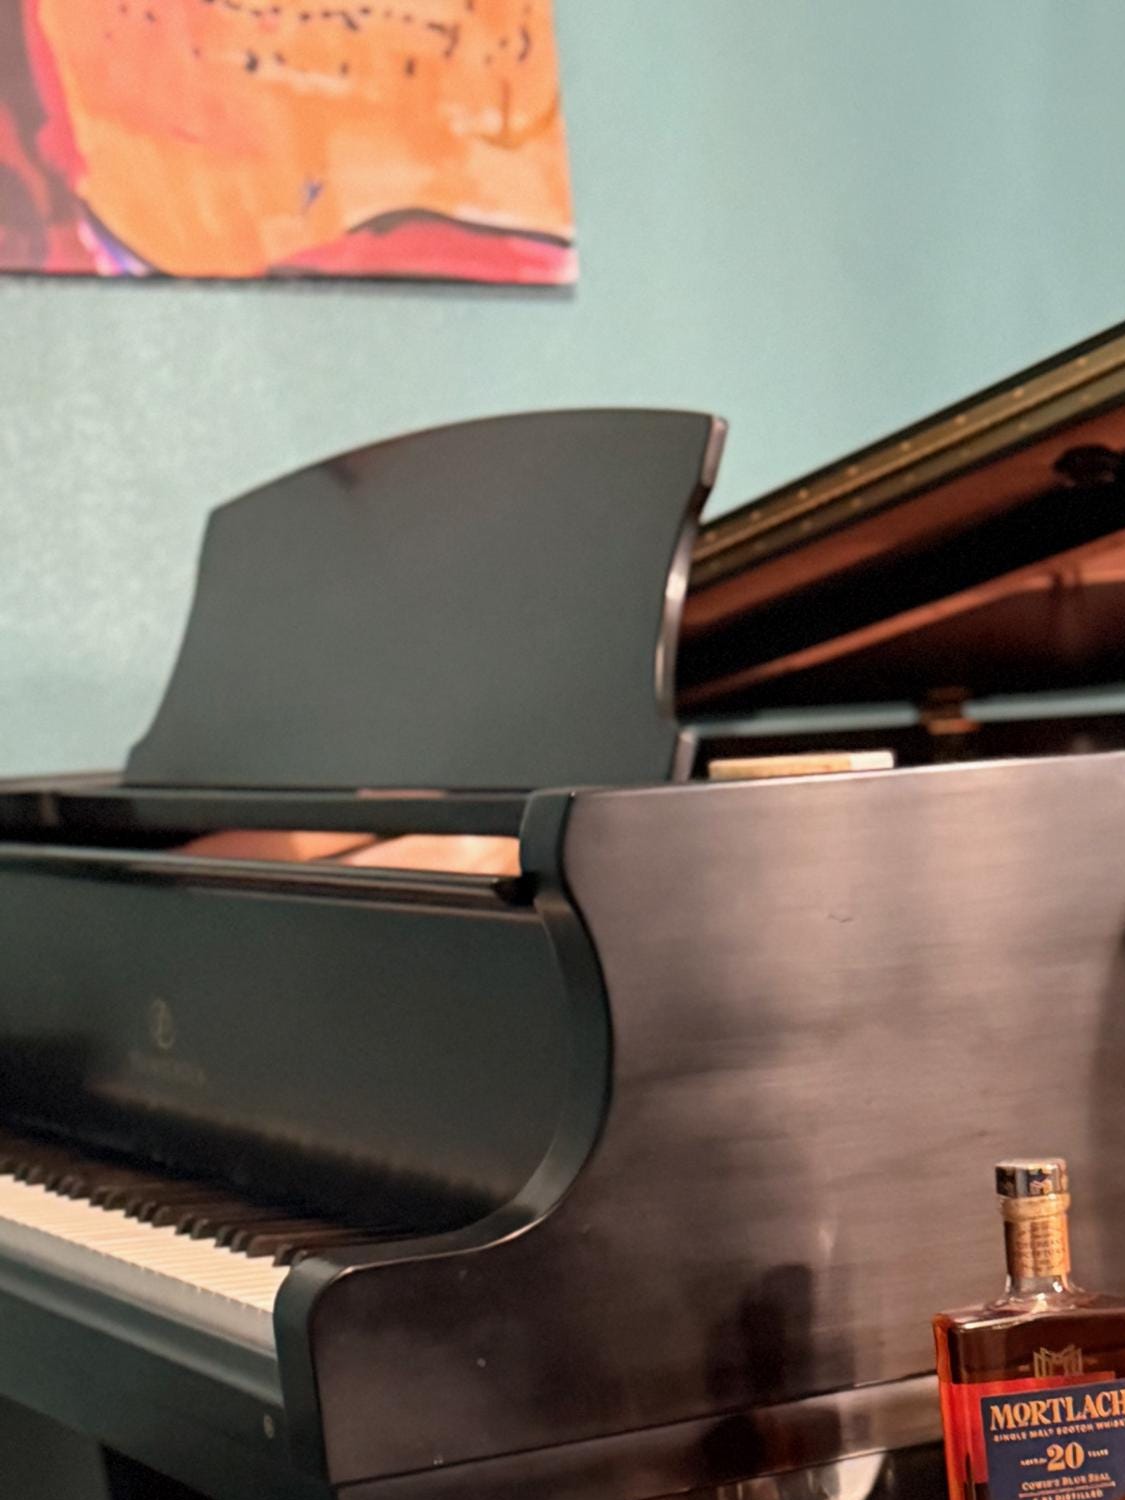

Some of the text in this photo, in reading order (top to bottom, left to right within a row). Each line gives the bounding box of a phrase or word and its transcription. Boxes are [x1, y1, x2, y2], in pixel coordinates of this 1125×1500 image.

[993, 1431, 1027, 1442] SINGLE
[1029, 1427, 1054, 1438] MALT
[1056, 1423, 1094, 1436] SCOTCH
[1046, 1441, 1085, 1472] 20
